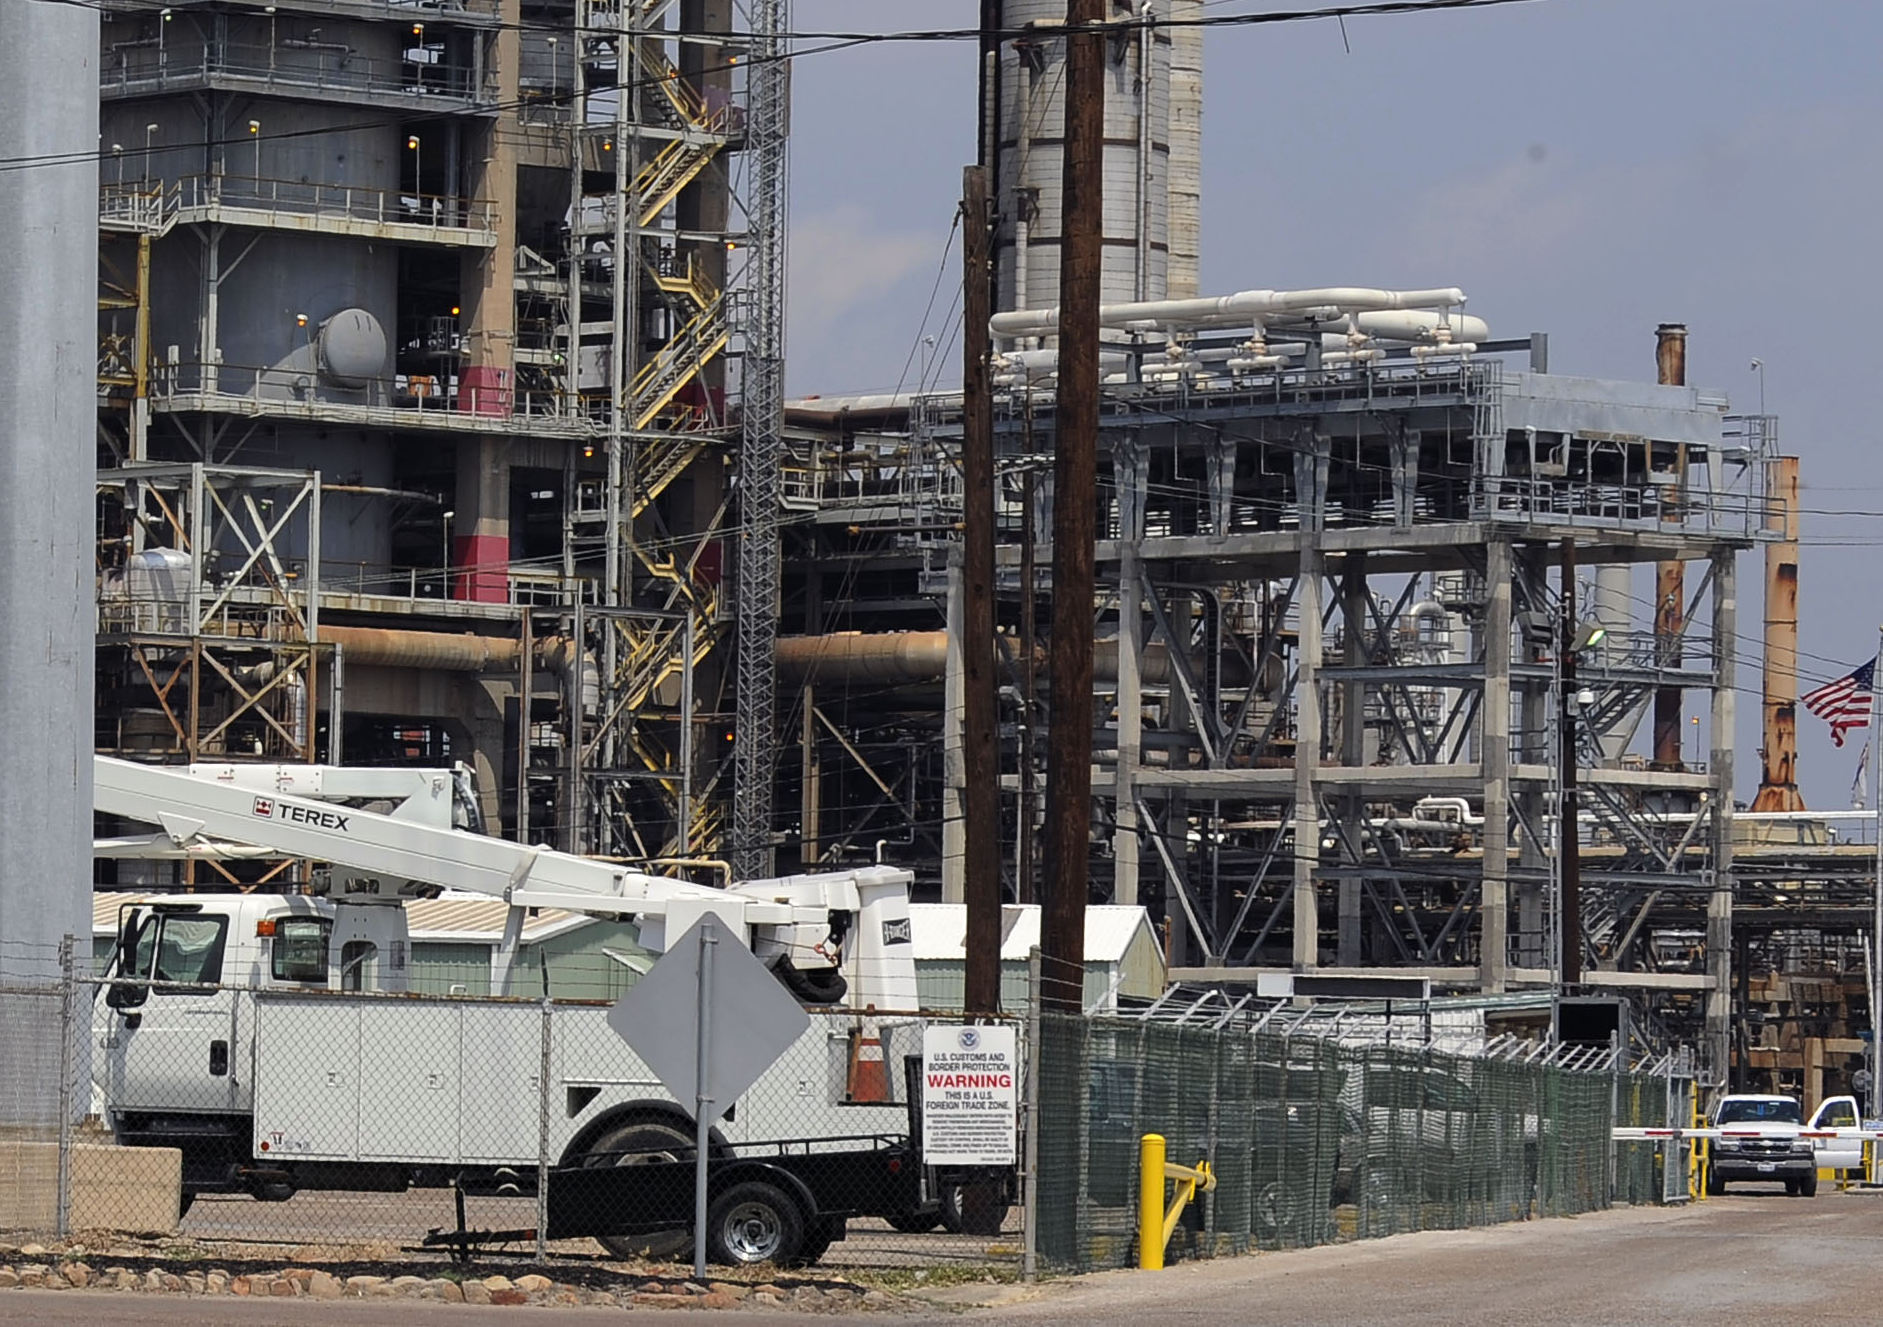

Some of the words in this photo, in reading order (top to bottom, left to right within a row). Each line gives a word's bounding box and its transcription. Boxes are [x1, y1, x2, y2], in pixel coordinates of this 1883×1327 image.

[278, 803, 350, 832] TEREX
[933, 1053, 948, 1061] U.S.
[949, 1053, 987, 1062] CUSTOMS
[988, 1053, 1005, 1062] AND
[928, 1063, 960, 1071] BORDER
[961, 1063, 1011, 1072] PROTECTION
[927, 1074, 1012, 1088] WARNING
[945, 1091, 961, 1100] THIS
[963, 1091, 971, 1100] IS
[972, 1091, 978, 1100] A
[979, 1091, 994, 1100] U.S.
[926, 1101, 959, 1110] FOREIGN
[961, 1101, 986, 1110] TRADE
[988, 1101, 1011, 1110] ZONE.
